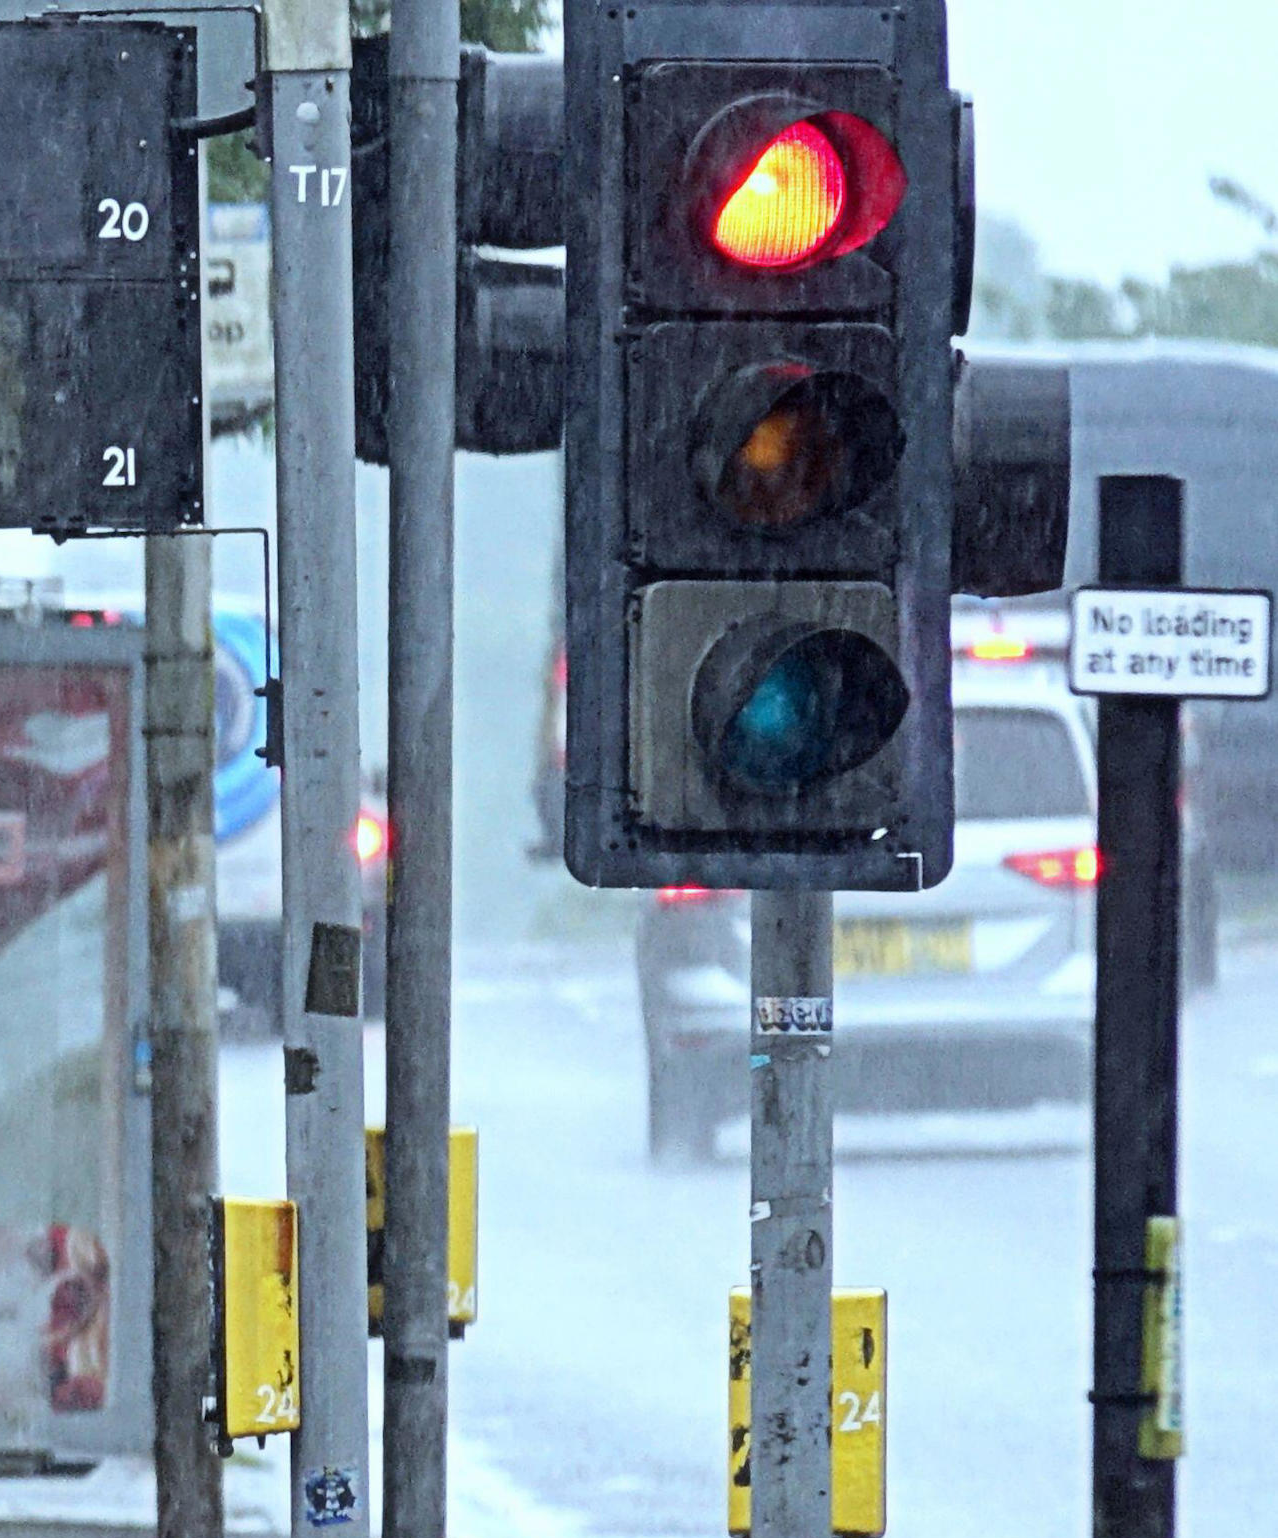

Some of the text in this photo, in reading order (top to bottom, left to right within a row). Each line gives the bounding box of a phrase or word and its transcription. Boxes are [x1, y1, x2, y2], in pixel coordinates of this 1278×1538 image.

[97, 197, 150, 242] 20
[101, 445, 136, 486] 21
[1090, 605, 1254, 646] No loading
[1087, 649, 1257, 681] at any time
[256, 1383, 299, 1424] 24
[839, 1389, 882, 1432] 24
